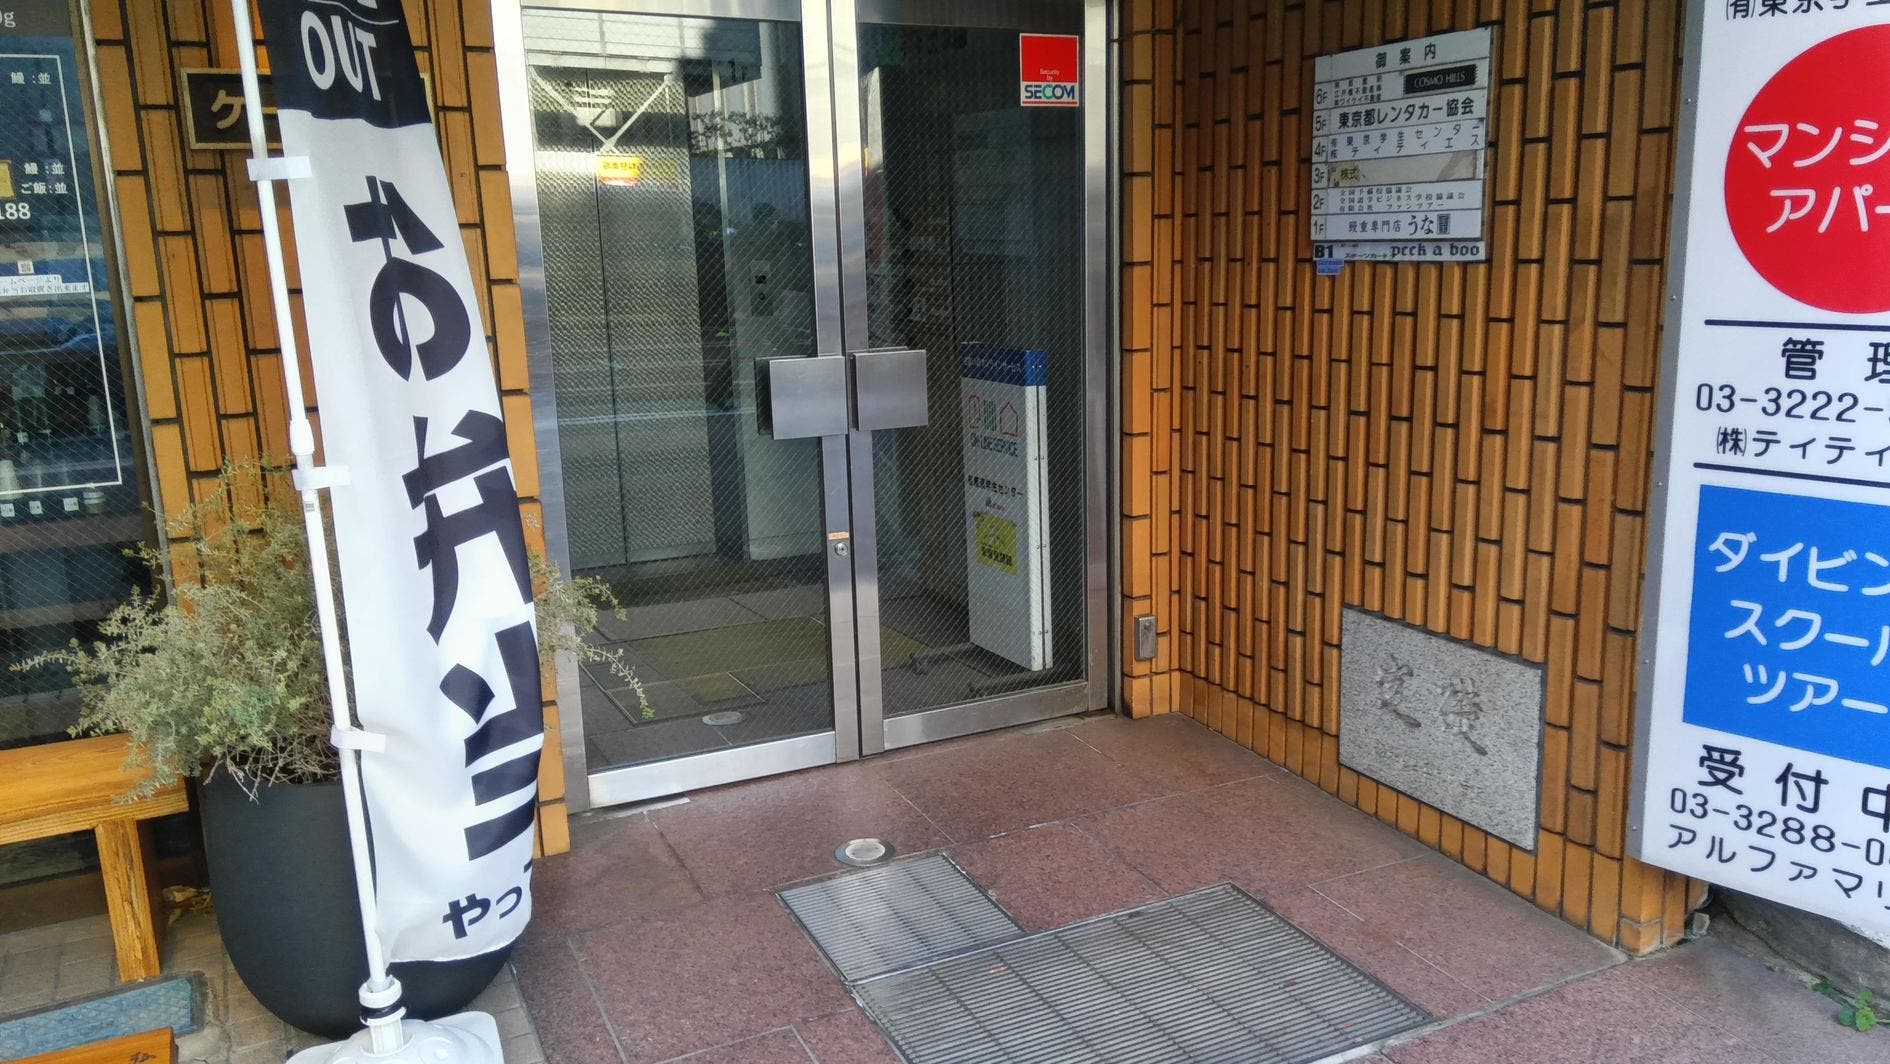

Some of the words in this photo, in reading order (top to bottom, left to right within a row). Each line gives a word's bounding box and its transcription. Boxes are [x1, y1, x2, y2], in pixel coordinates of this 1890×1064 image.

[0, 9, 16, 28] g
[301, 10, 381, 101] OUT
[1375, 42, 1437, 69] 御案内
[1414, 74, 1443, 89] COSMO
[1445, 71, 1466, 85] HILLS
[1024, 84, 1075, 100] SECOM
[1316, 88, 1328, 105] 6F
[1315, 115, 1327, 131] 5F
[1338, 97, 1475, 129] 東京都レンタカー協会
[1314, 141, 1326, 156] 4F
[1744, 119, 1890, 168] マンシ
[1314, 167, 1326, 184] 3F
[1313, 195, 1325, 211] 2F
[1313, 220, 1325, 235] 1F
[1315, 244, 1334, 258] B1
[1432, 245, 1443, 256] a
[1449, 242, 1480, 256] boo
[1781, 336, 1890, 384] 管理
[1695, 383, 1890, 424] 03-3222-
[1708, 531, 1890, 597] ダイビン
[1743, 663, 1890, 715] ツアー
[1697, 744, 1890, 834] 受付中
[1669, 787, 1890, 867] 03-3288-0
[442, 859, 533, 940] やっ
